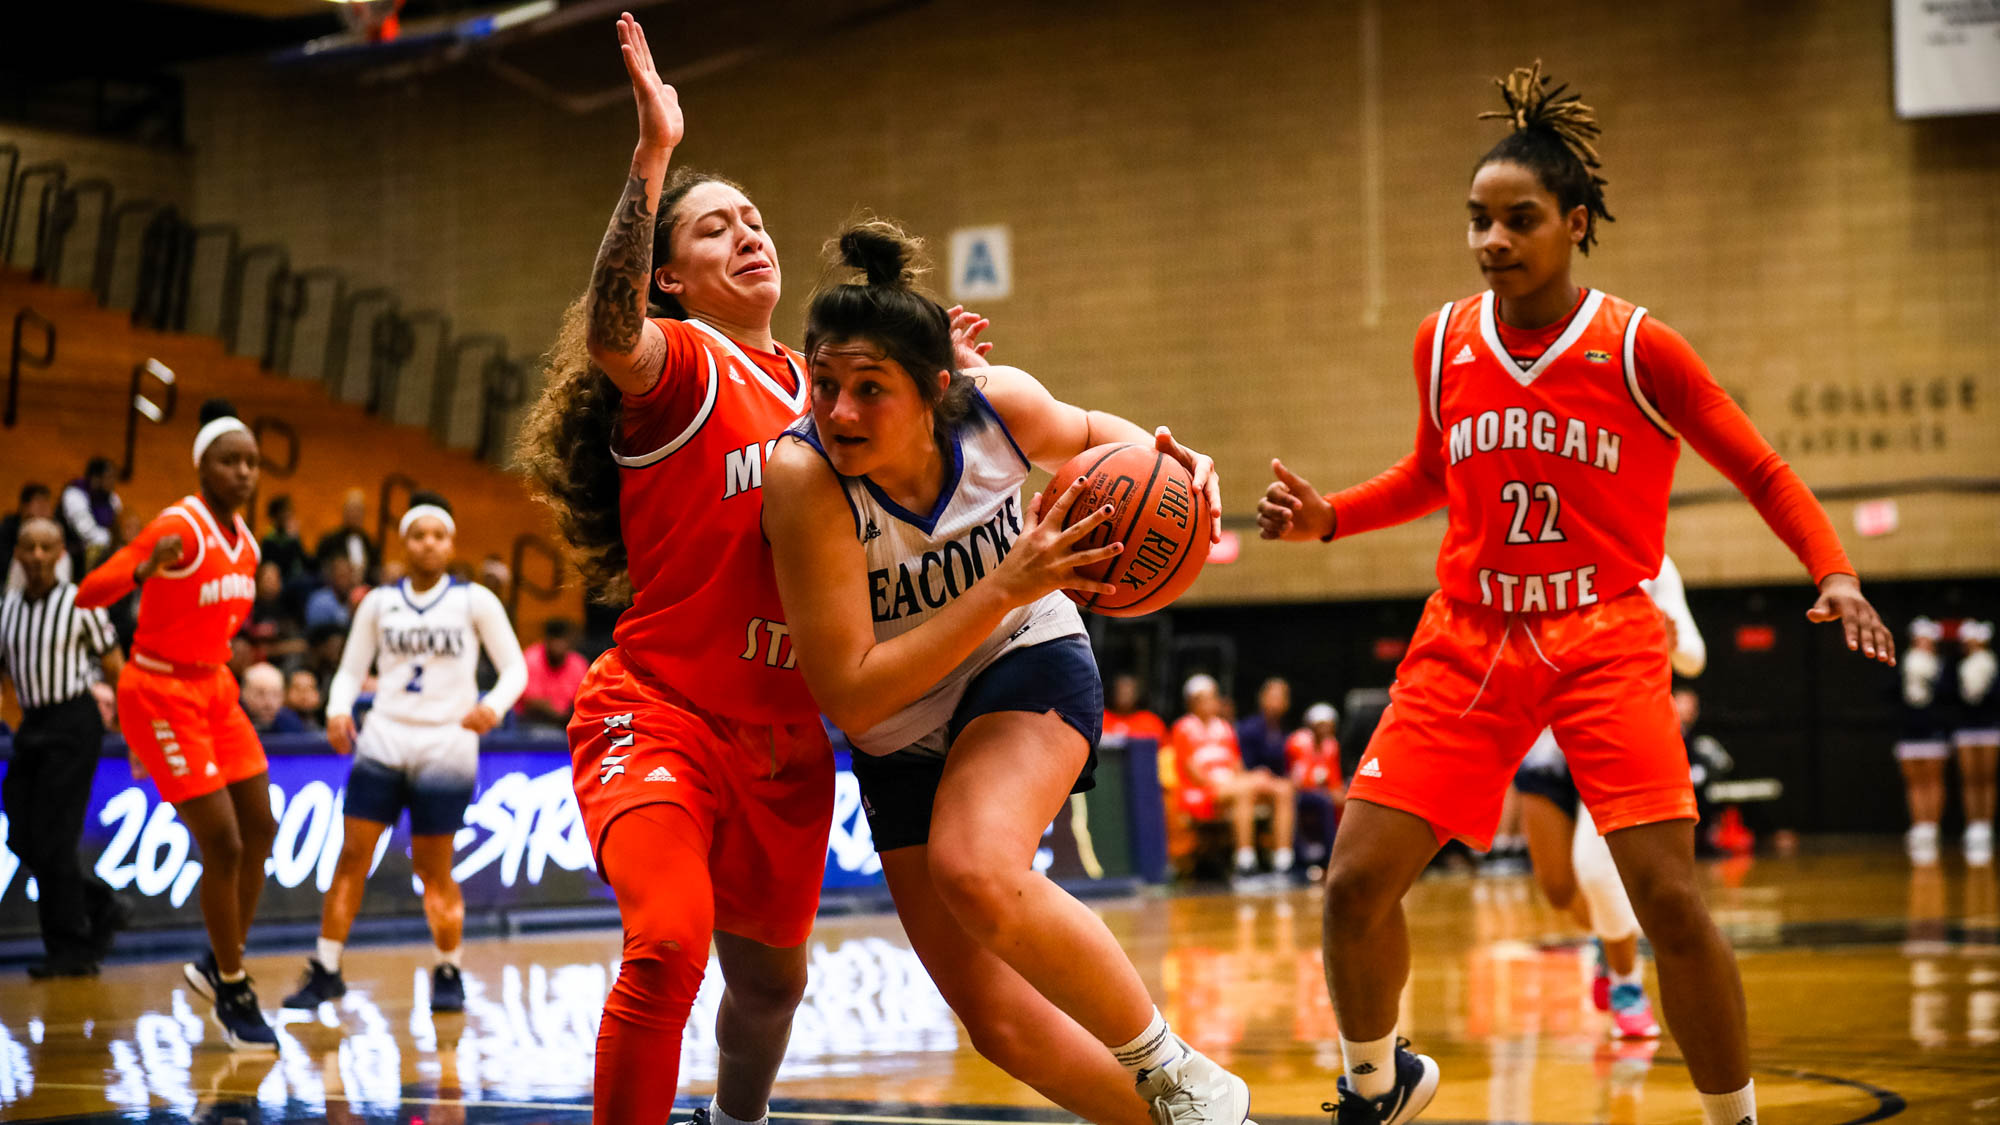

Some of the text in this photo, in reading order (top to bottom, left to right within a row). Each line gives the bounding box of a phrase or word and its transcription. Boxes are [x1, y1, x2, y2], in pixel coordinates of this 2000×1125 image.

[964, 239, 997, 285] A
[1449, 406, 1621, 474] MORGAN
[1155, 475, 1189, 530] THE
[1500, 480, 1567, 545] 22
[868, 496, 1021, 623] EACOCKS
[1119, 527, 1180, 592] ROCK
[1478, 564, 1598, 614] STATE
[405, 665, 423, 692] 2
